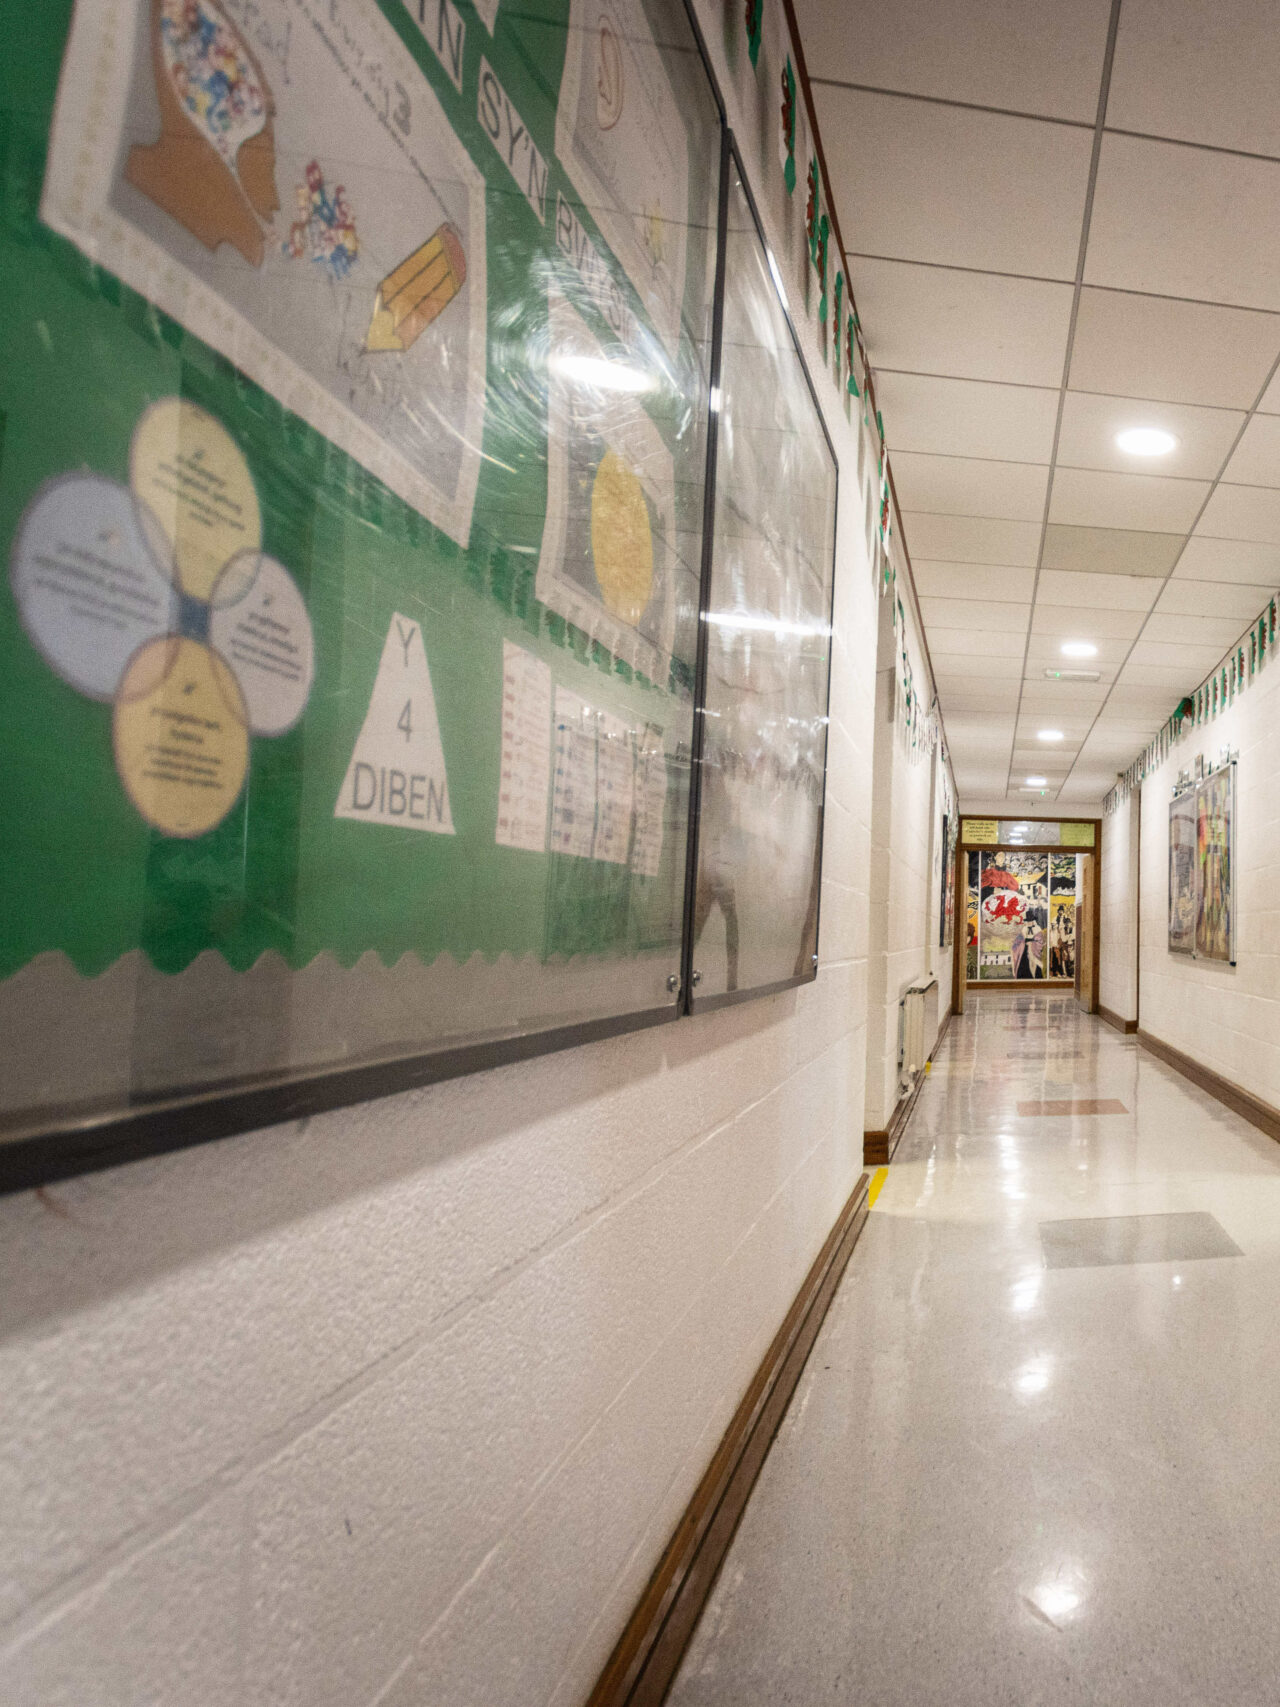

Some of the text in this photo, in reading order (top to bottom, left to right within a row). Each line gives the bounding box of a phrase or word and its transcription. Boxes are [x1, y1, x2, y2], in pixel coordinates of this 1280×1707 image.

[396, 620, 415, 668] Y
[397, 699, 413, 744] 4
[352, 761, 445, 823] DIBEN
